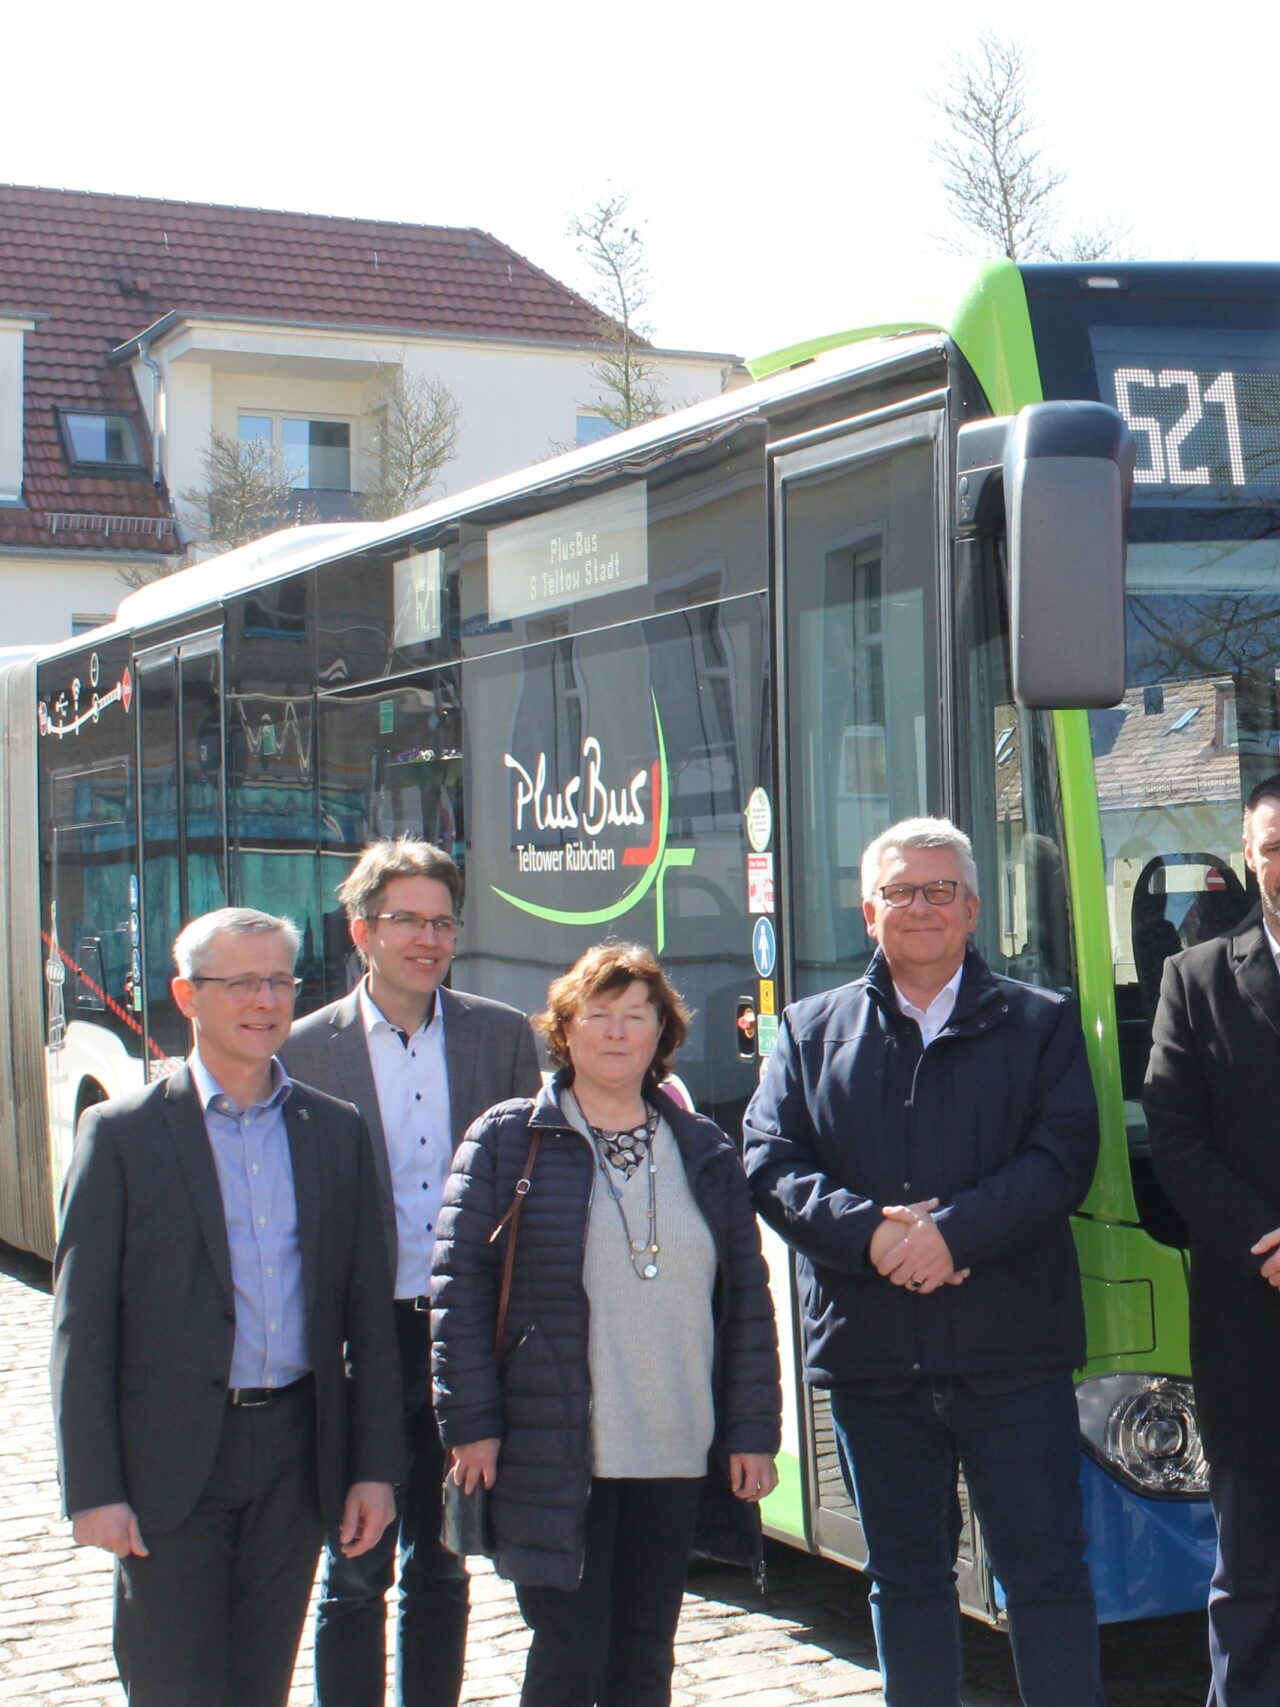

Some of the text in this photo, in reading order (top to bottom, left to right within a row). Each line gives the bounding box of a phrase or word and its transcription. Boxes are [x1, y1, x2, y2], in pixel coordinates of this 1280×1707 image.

[549, 530, 599, 565] PlusBus
[541, 567, 581, 598] Teltow
[584, 551, 622, 586] Stadt
[503, 735, 648, 837] PlusBus
[515, 840, 616, 873] Teltower Rübchen
